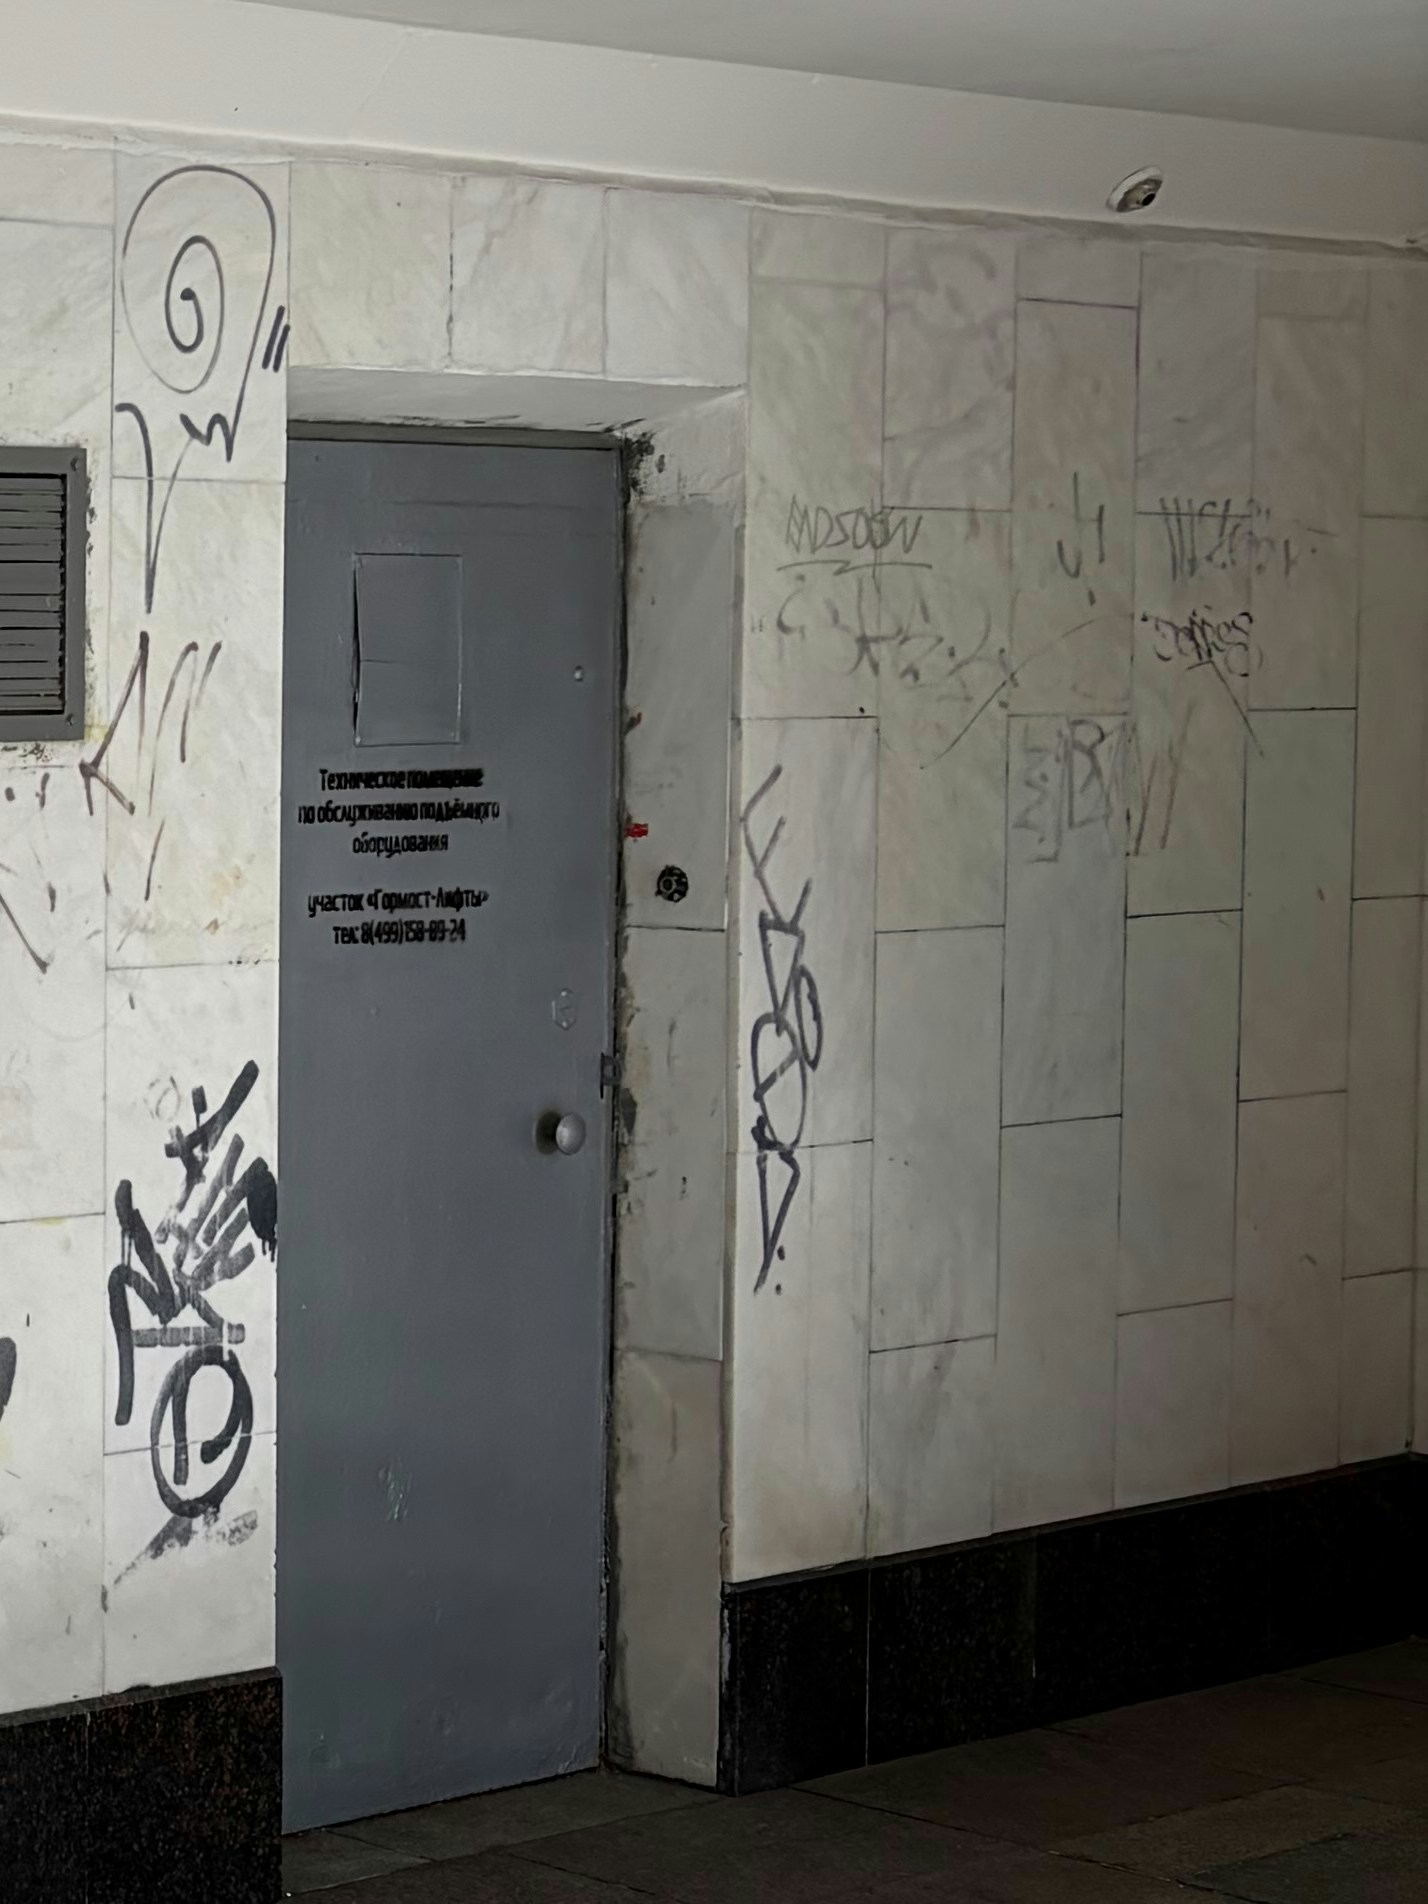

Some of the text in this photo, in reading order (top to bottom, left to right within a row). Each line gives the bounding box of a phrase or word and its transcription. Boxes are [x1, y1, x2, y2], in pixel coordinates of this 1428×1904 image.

[319, 769, 406, 791] Техническое
[298, 805, 315, 824] по
[317, 800, 418, 827] обслуживанию
[352, 832, 449, 858] оборудования
[308, 892, 365, 918] участок
